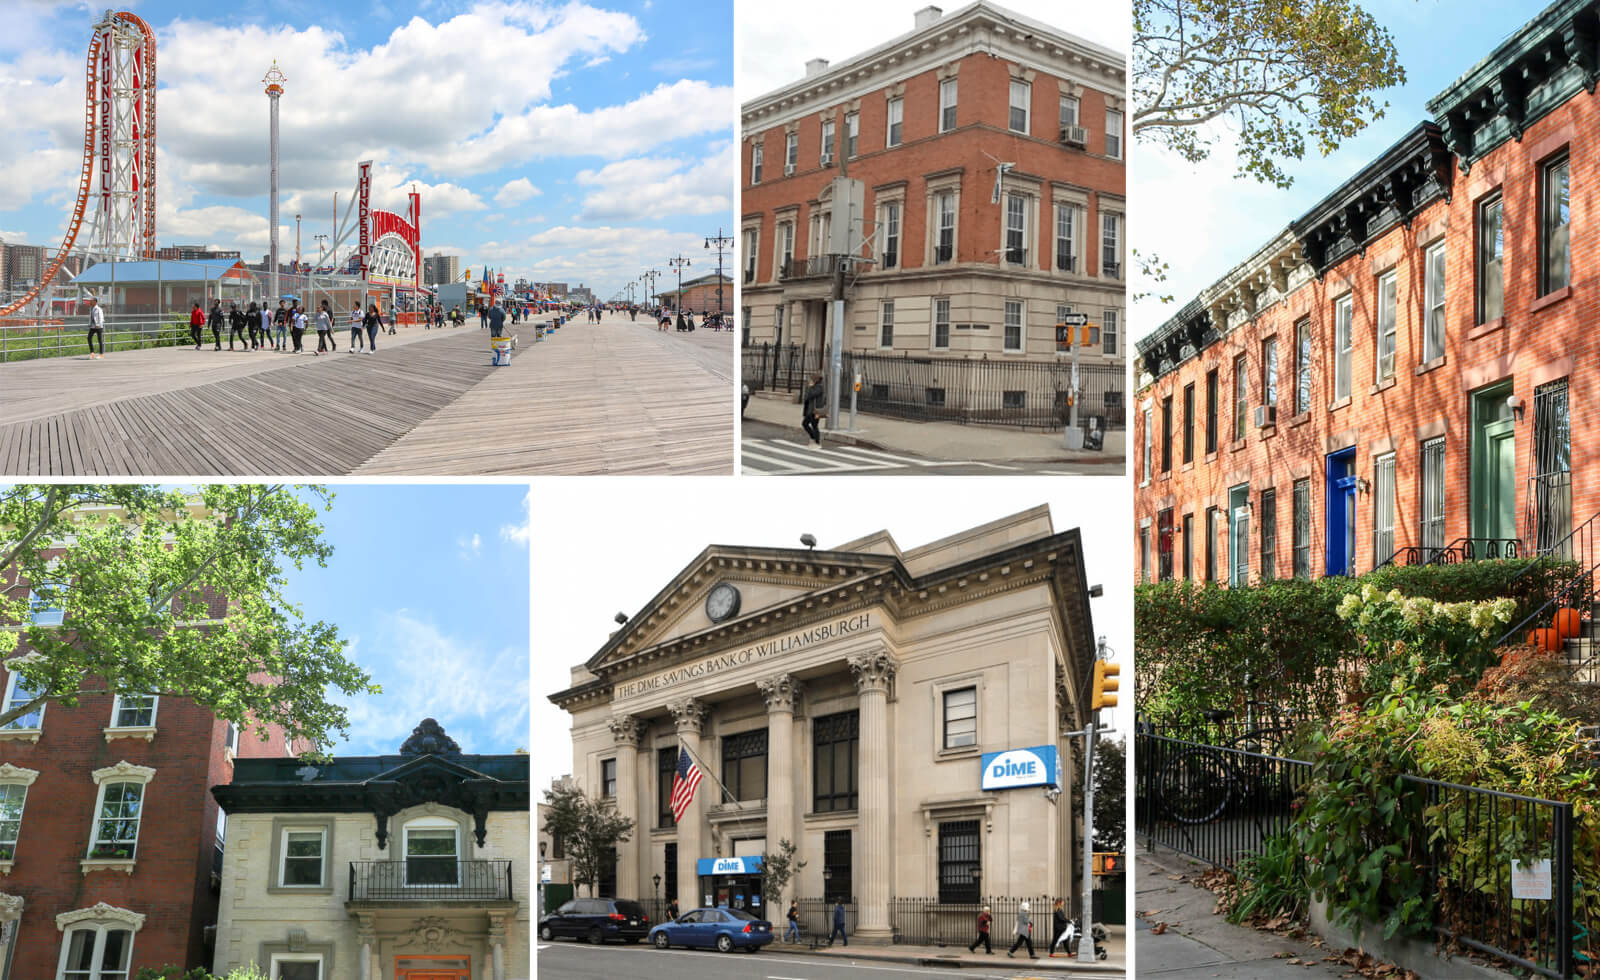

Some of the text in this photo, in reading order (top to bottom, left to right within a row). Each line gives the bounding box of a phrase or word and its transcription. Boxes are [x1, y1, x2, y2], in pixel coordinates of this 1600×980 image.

[101, 33, 111, 212] THUNDERBOLT
[359, 164, 369, 281] THUNDERBOLT
[618, 613, 871, 698] THE DIME SAVINGS BANK OF WILLIAMSBURGH
